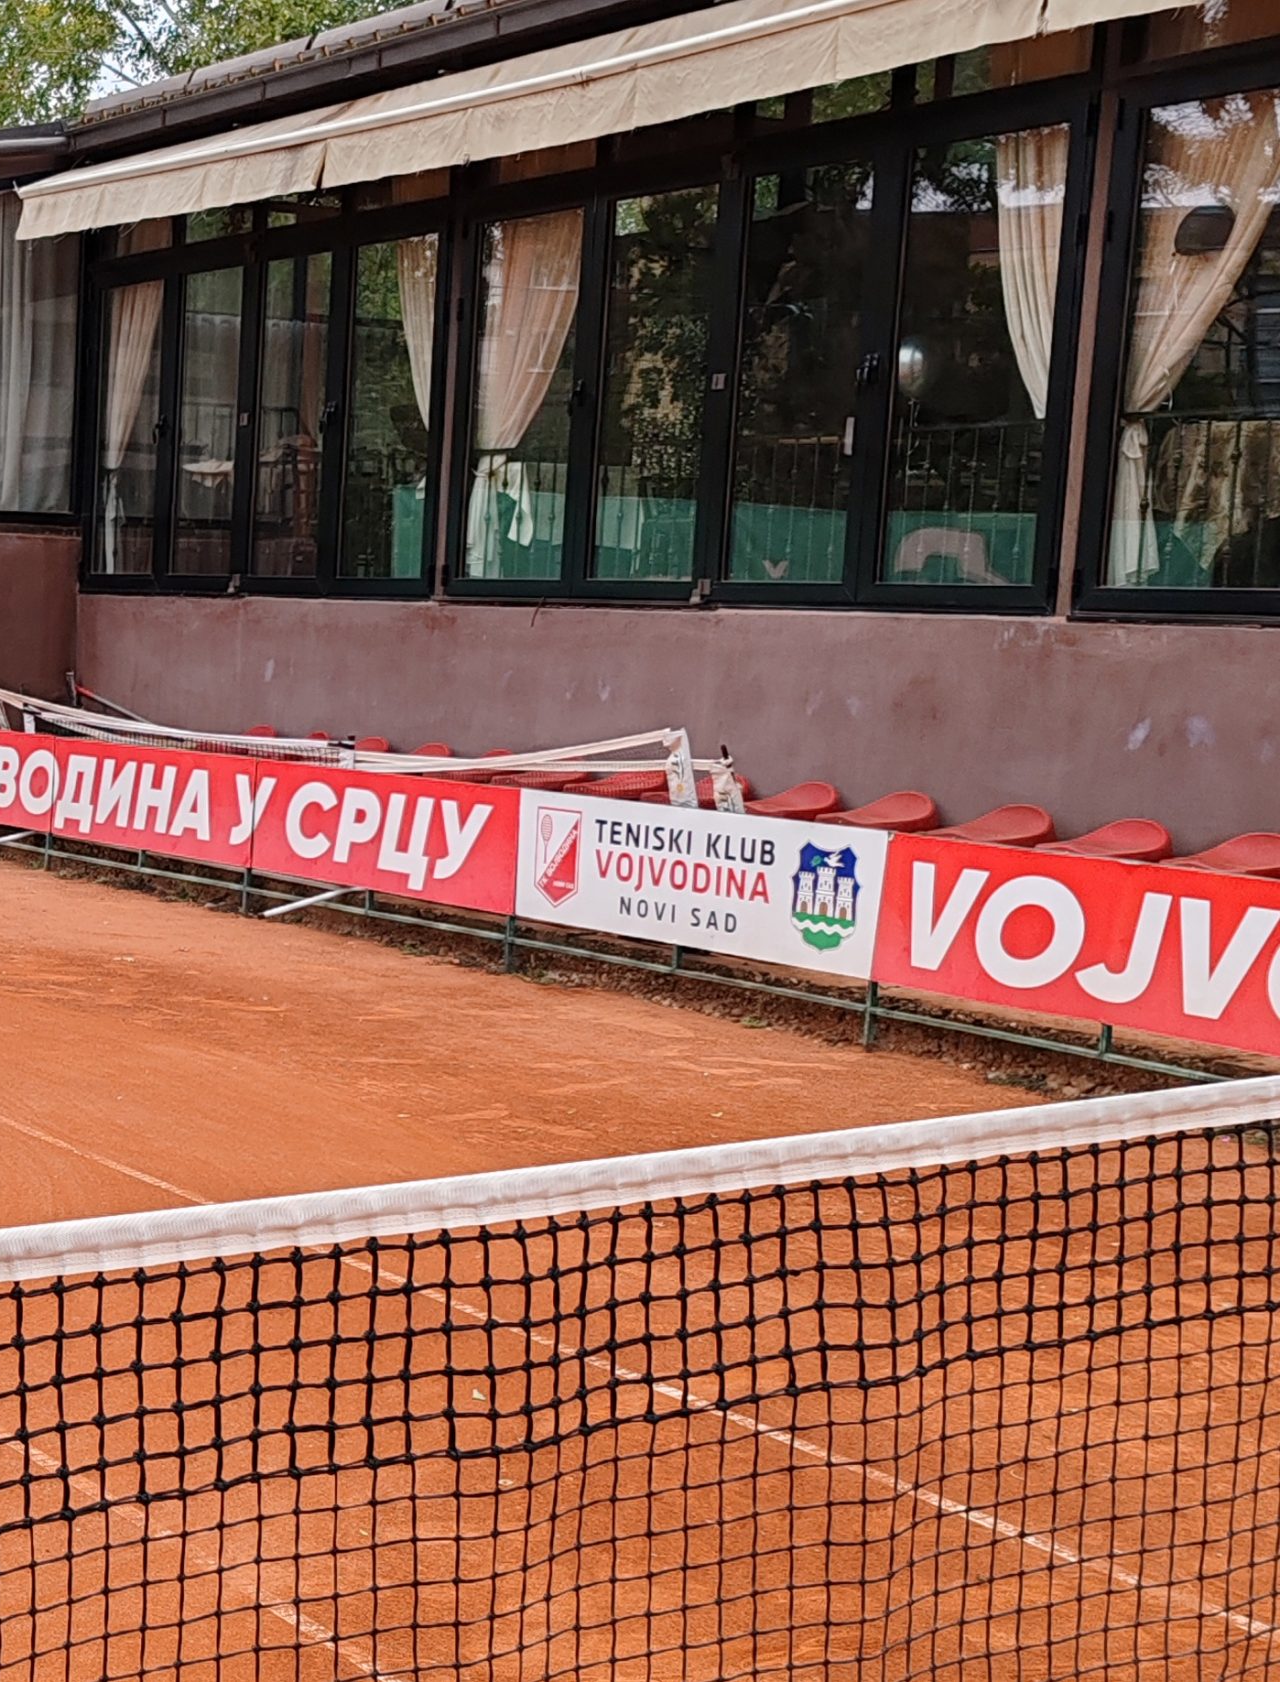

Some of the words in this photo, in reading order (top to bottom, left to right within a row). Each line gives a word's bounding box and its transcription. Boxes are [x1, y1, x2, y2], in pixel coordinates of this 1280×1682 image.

[229, 773, 277, 846] У
[285, 781, 494, 891] СРЦУ
[595, 819, 692, 855] TENISKI
[706, 833, 776, 866] KLUB
[595, 849, 770, 904] VOJVODINA
[620, 896, 676, 923] NOVI
[690, 907, 738, 933] SAD
[910, 860, 1280, 1020] VOJV
